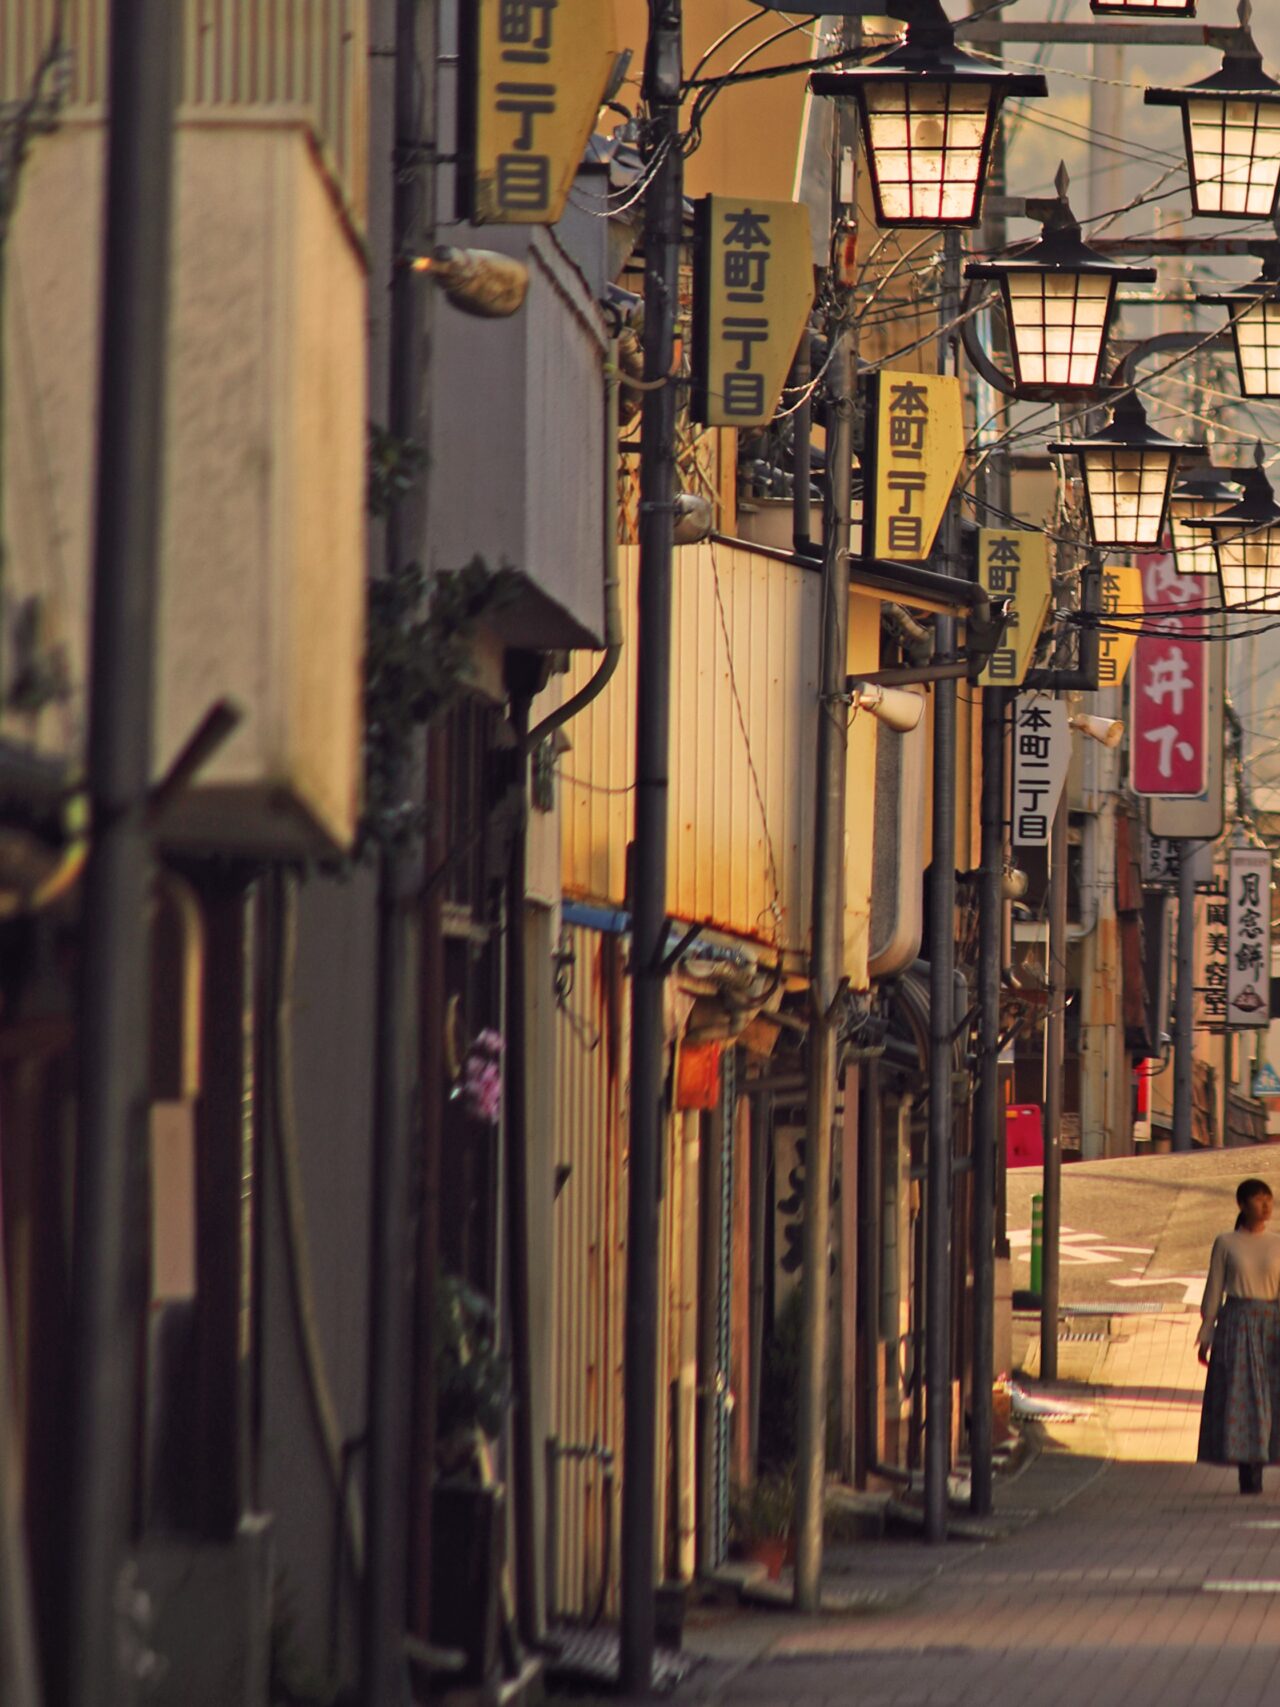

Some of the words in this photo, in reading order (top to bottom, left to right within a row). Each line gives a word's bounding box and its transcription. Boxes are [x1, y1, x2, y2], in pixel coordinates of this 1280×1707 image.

[722, 207, 771, 416] 本町二丁目
[887, 380, 929, 552] 本町二丁目
[1018, 706, 1052, 839] 本町二丁目
